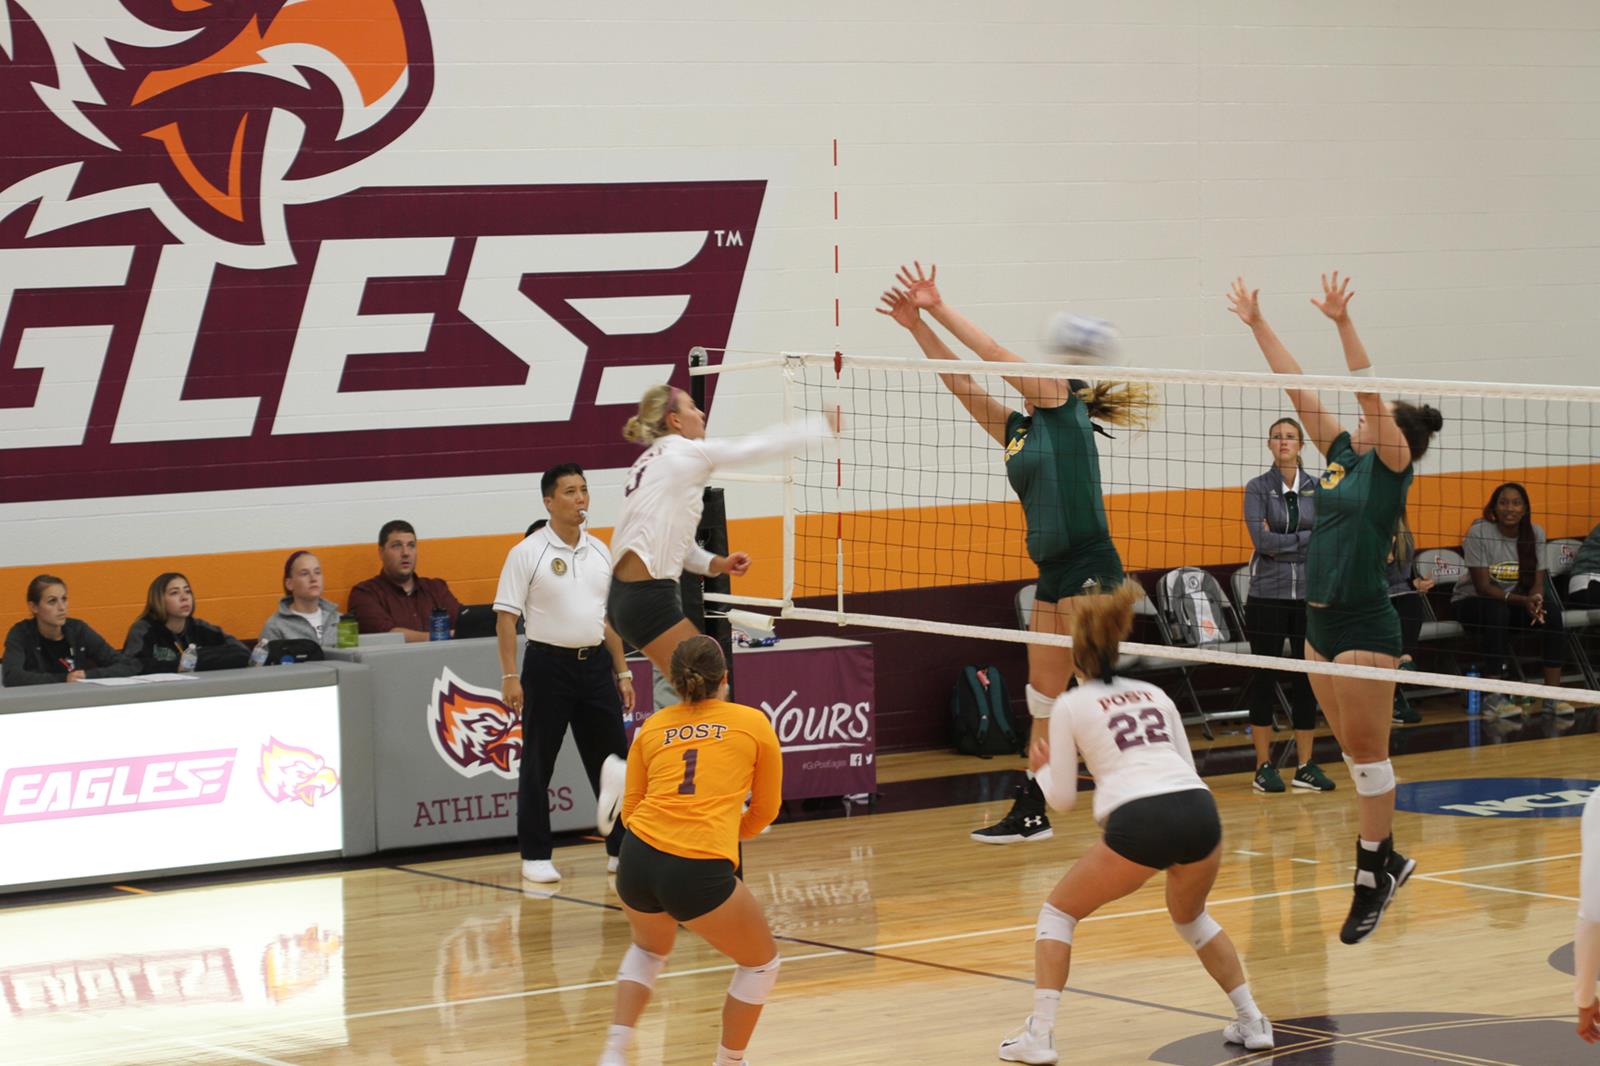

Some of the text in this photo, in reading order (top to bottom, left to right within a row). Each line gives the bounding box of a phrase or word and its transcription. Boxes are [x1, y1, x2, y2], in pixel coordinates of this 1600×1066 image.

[714, 229, 743, 247] TM
[760, 689, 870, 742] YOURS
[1097, 690, 1153, 713] POST
[663, 723, 728, 746] POST
[1108, 707, 1170, 752] 22
[3, 756, 235, 817] EAGLES
[678, 748, 698, 795] 1
[414, 786, 574, 828] ATHLECS
